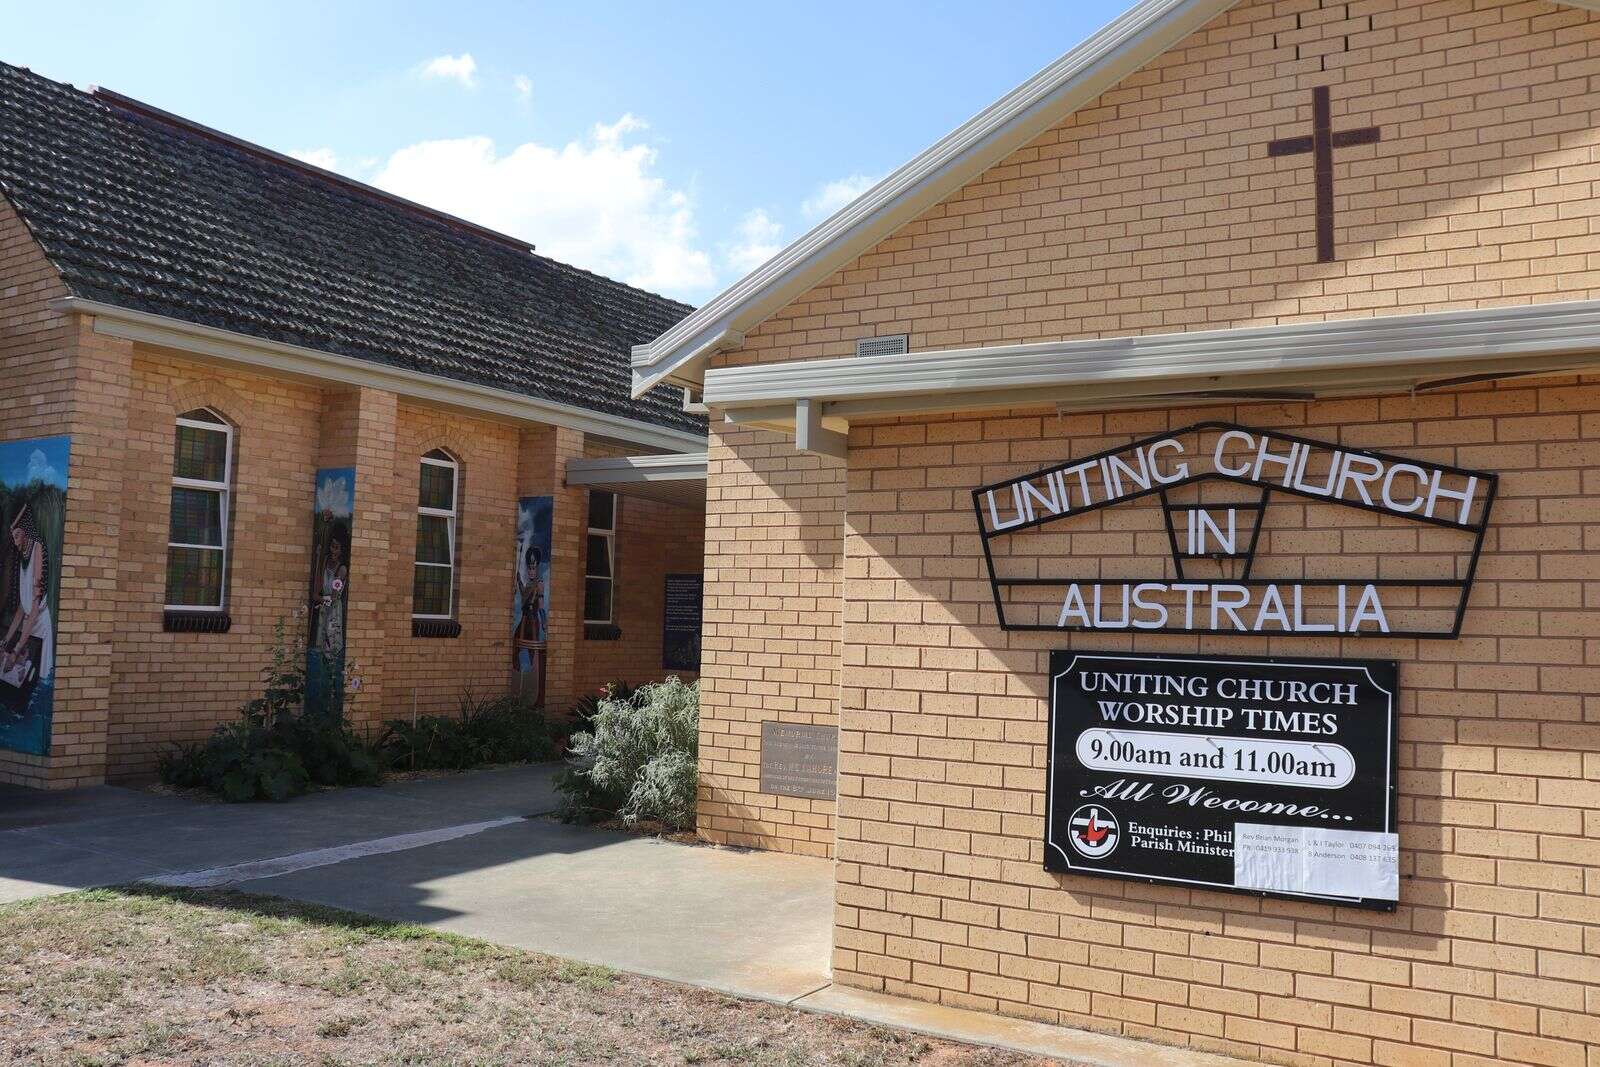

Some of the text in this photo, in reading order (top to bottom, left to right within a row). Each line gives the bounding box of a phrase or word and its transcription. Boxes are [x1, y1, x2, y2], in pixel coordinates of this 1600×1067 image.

[987, 430, 1477, 531] UNITING CHURCH
[1187, 508, 1236, 555] IN
[1057, 583, 1390, 633] AUSTRALIA
[1079, 671, 1359, 705] UNITING CHURCH
[1097, 700, 1338, 735] WORSHIP TIMES
[1091, 738, 1337, 778] 9.00am and 11.00am
[1079, 778, 1154, 802] All
[1128, 821, 1192, 840] Enquiries
[1203, 828, 1233, 844] Phil
[1131, 835, 1235, 858] Parish Minister
[1313, 851, 1346, 860] Anderson
